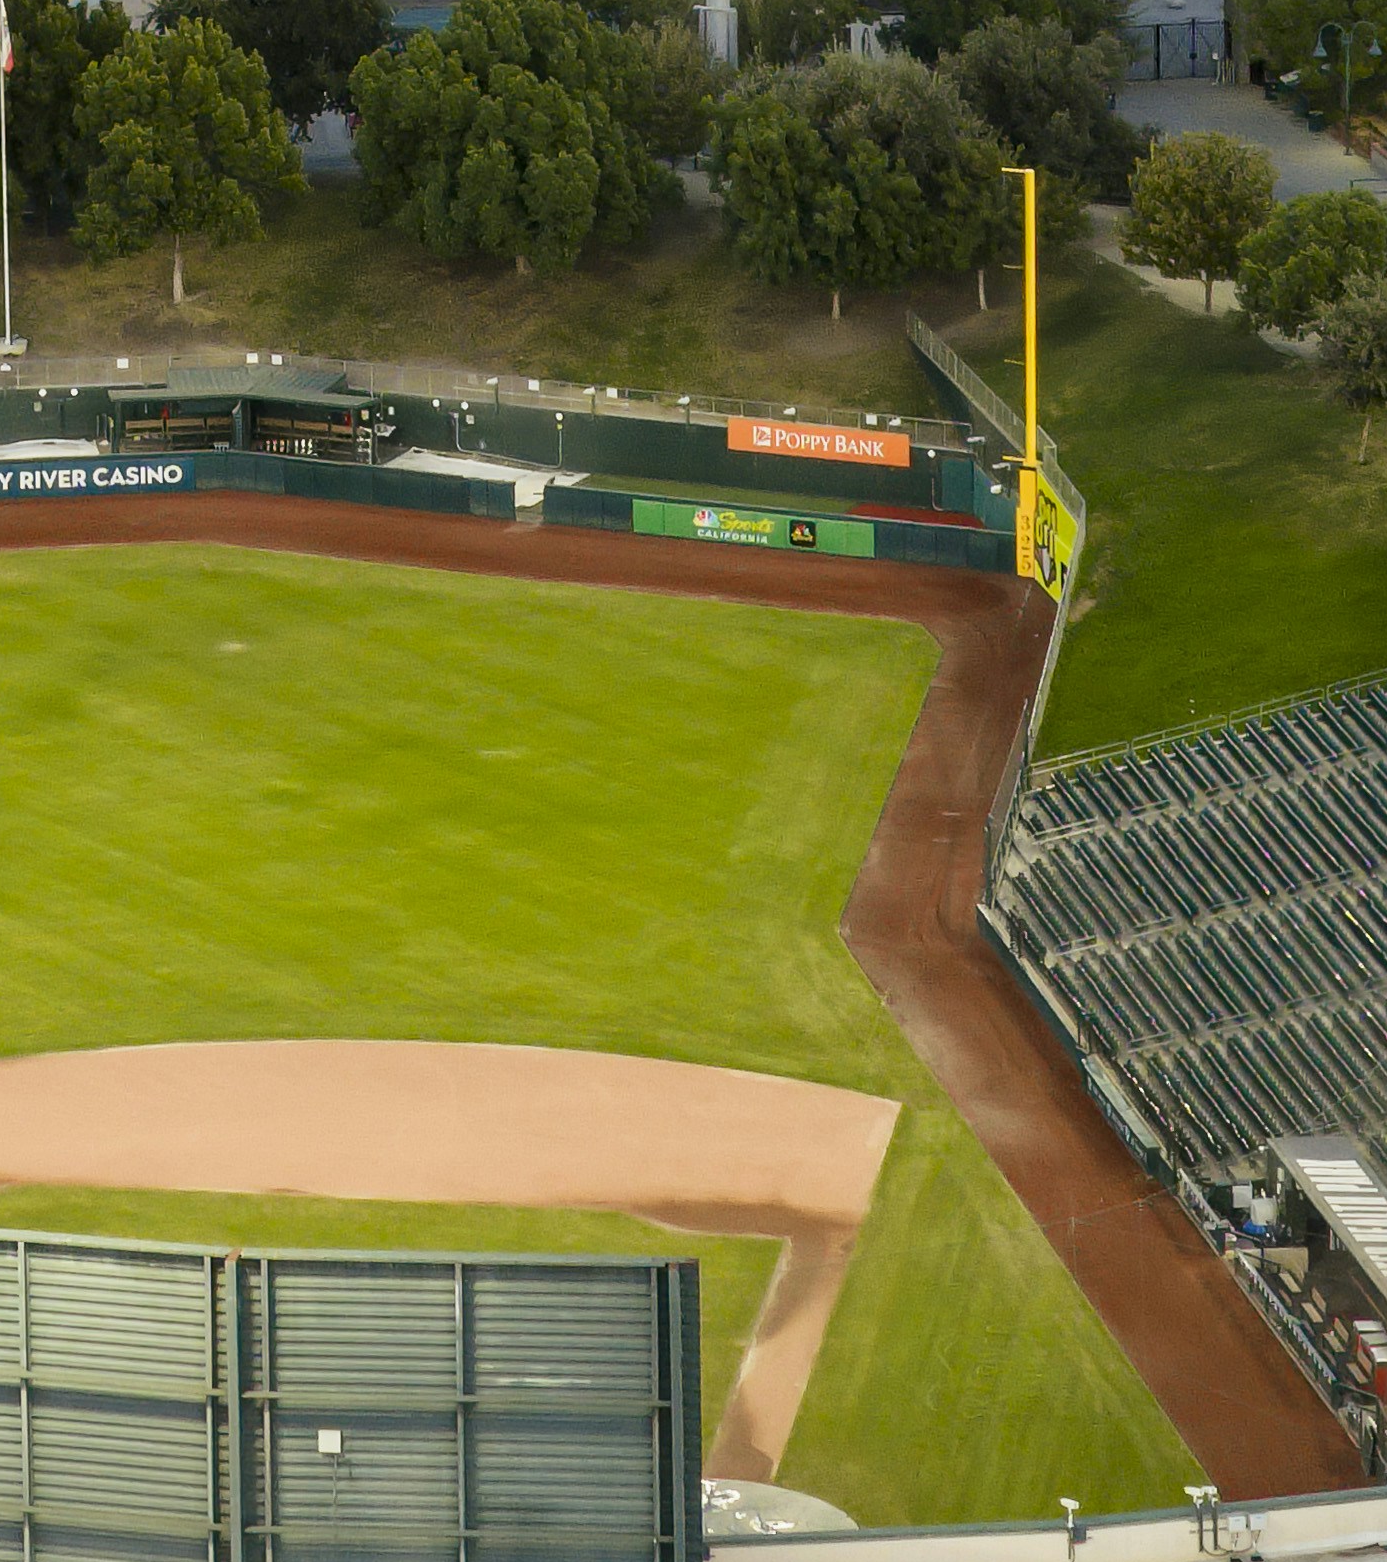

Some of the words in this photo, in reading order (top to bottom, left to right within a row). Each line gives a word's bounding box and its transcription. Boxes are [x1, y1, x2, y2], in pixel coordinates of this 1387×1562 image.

[775, 429, 831, 452] POPPY
[835, 435, 884, 458] BANK
[19, 468, 87, 491] RIVER
[92, 464, 183, 487] CASINO
[718, 510, 775, 534] Sports
[697, 528, 768, 544] CALIFORNIA
